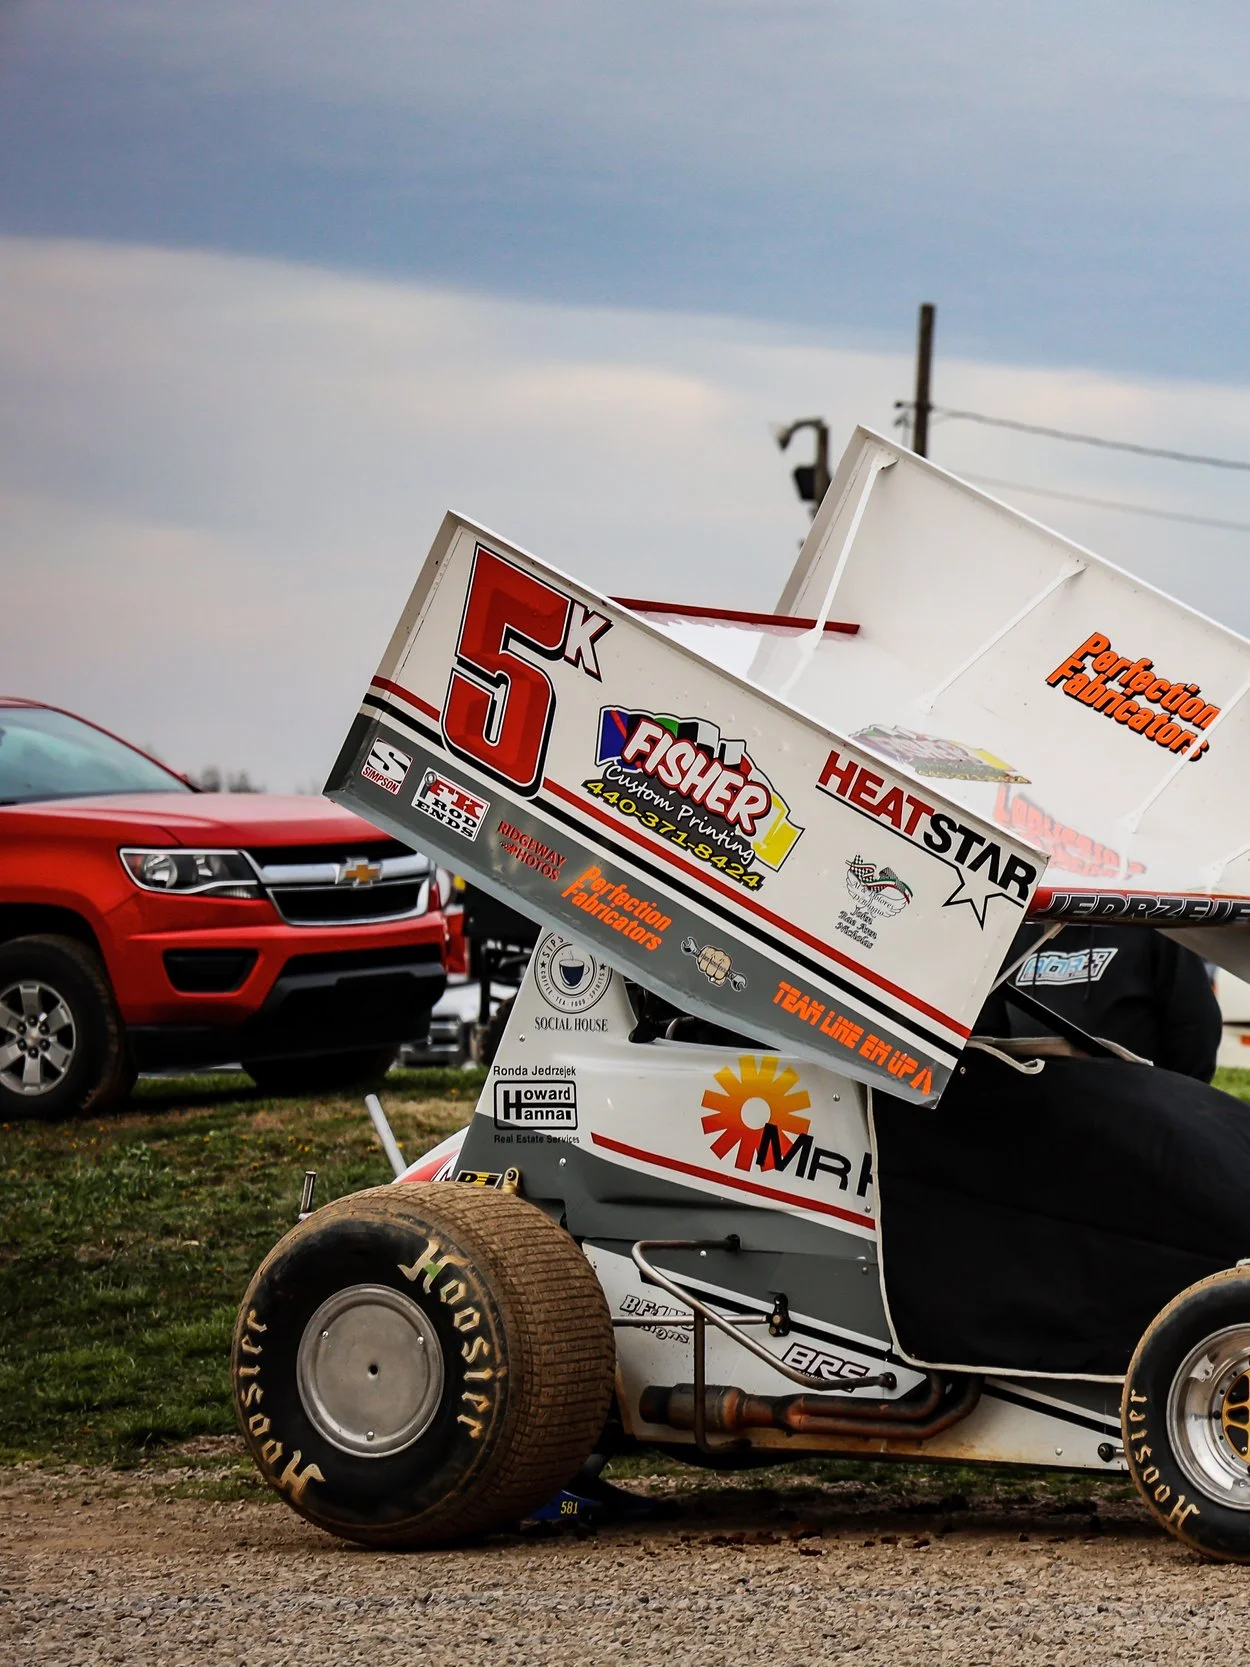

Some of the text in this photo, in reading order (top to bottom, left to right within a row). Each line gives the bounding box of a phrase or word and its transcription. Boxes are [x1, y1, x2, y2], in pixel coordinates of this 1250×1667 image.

[1070, 631, 1222, 731] Perfection
[1045, 656, 1210, 761] Fabricators
[362, 766, 398, 793] SIMPSON
[622, 719, 771, 835] FISHER
[414, 798, 475, 838] ENDS
[428, 778, 484, 820] FK
[432, 797, 477, 828] ROD
[605, 765, 756, 864] Custom Printing
[497, 820, 567, 867] RIDGEWAY
[586, 781, 763, 888] 440-371-8424
[561, 884, 662, 952] Fabricators
[571, 865, 672, 932] Perfection
[540, 970, 552, 995] COFFEE
[555, 995, 567, 1006] TEA
[589, 972, 606, 999] SPIRITS
[534, 1016, 608, 1032] SOCIAL HOUSE
[772, 981, 826, 1026] TEAM
[819, 1011, 864, 1049] LINE
[858, 1034, 893, 1066] EM
[887, 1050, 919, 1078] UP
[493, 1065, 576, 1078] Ronda Jedrzejek
[503, 1086, 571, 1104] Howard
[494, 1134, 580, 1144] Real Estate Services
[560, 1500, 578, 1515] 581
